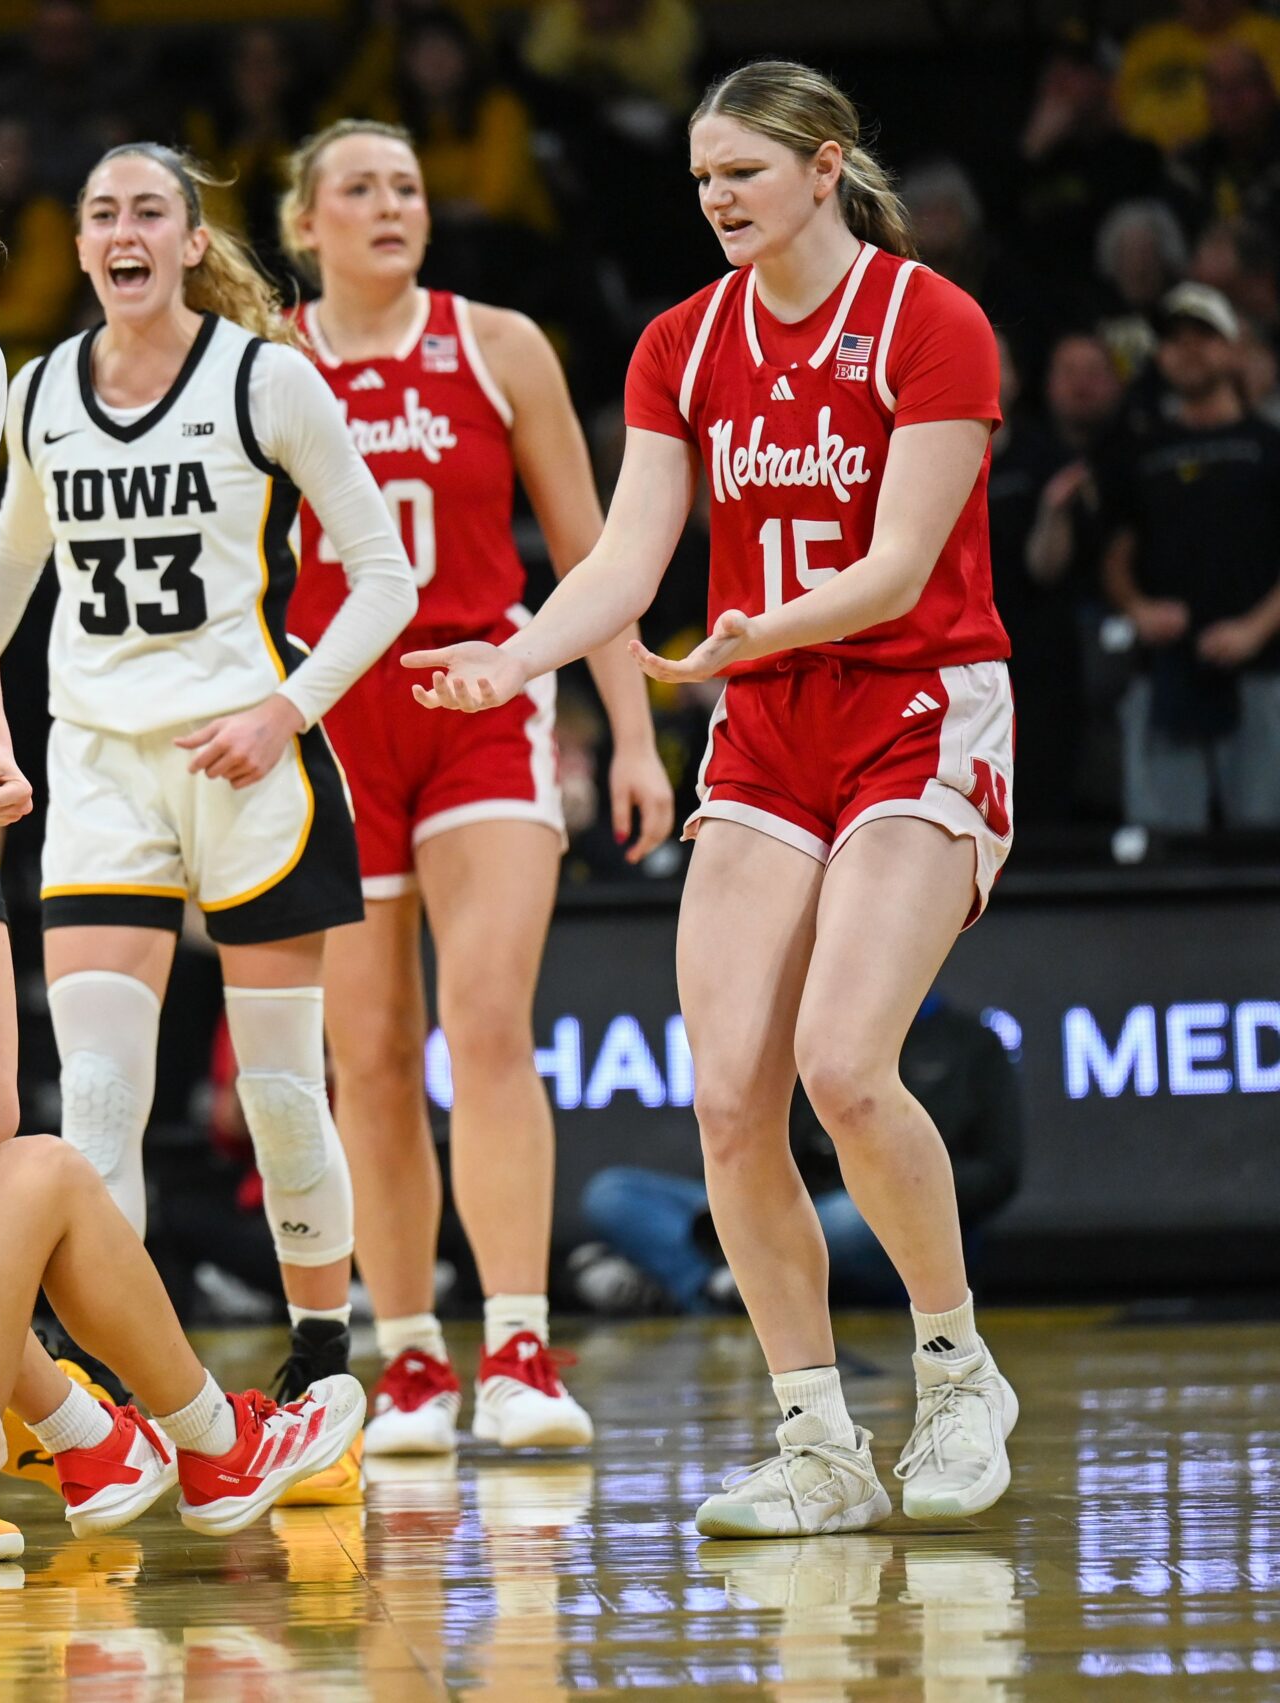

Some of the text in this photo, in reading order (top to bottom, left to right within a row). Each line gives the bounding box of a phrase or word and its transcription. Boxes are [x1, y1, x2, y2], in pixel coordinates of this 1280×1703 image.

[338, 387, 458, 464] raska
[708, 405, 870, 503] Nebraska
[52, 461, 217, 523] IOWA
[68, 533, 208, 637] 33
[759, 518, 843, 614] 15
